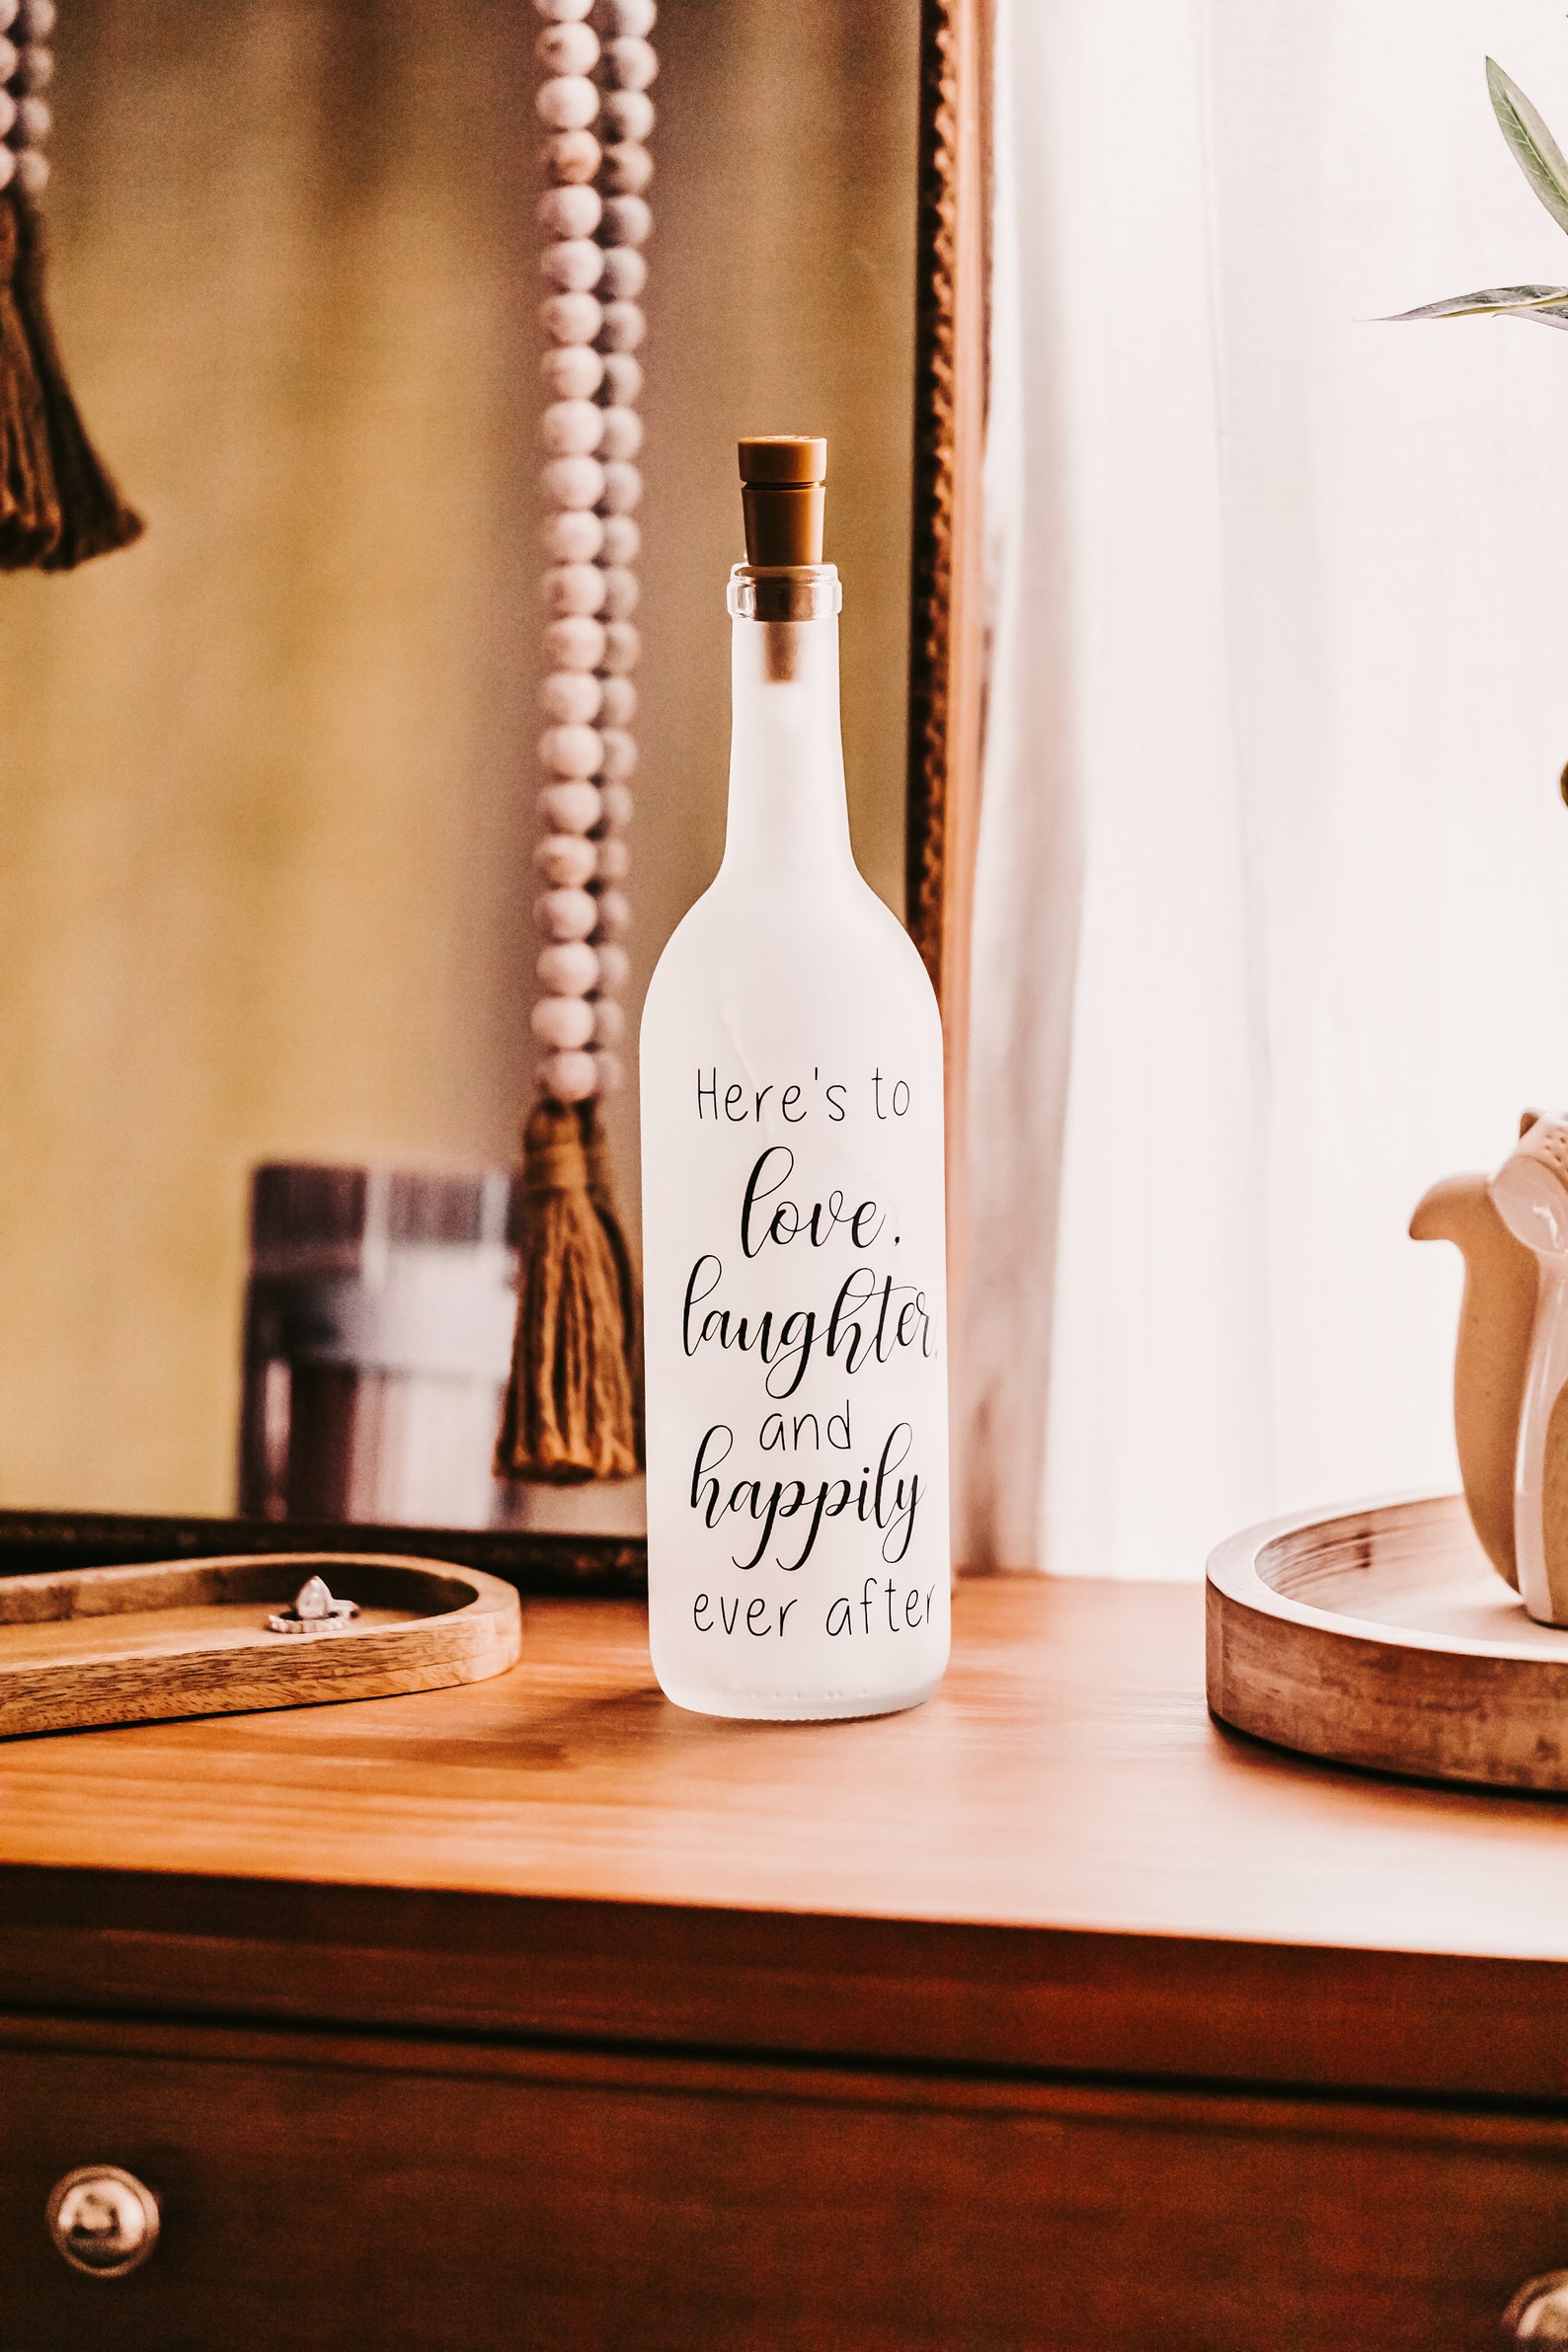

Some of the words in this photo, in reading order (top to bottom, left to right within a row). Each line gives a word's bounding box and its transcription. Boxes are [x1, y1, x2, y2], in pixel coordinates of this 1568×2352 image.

[696, 1065, 848, 1124] Here's
[871, 1065, 911, 1121] to
[758, 1397, 853, 1452] and
[690, 1422, 926, 1572] happily
[693, 1592, 799, 1638] ever
[825, 1576, 936, 1637] after
